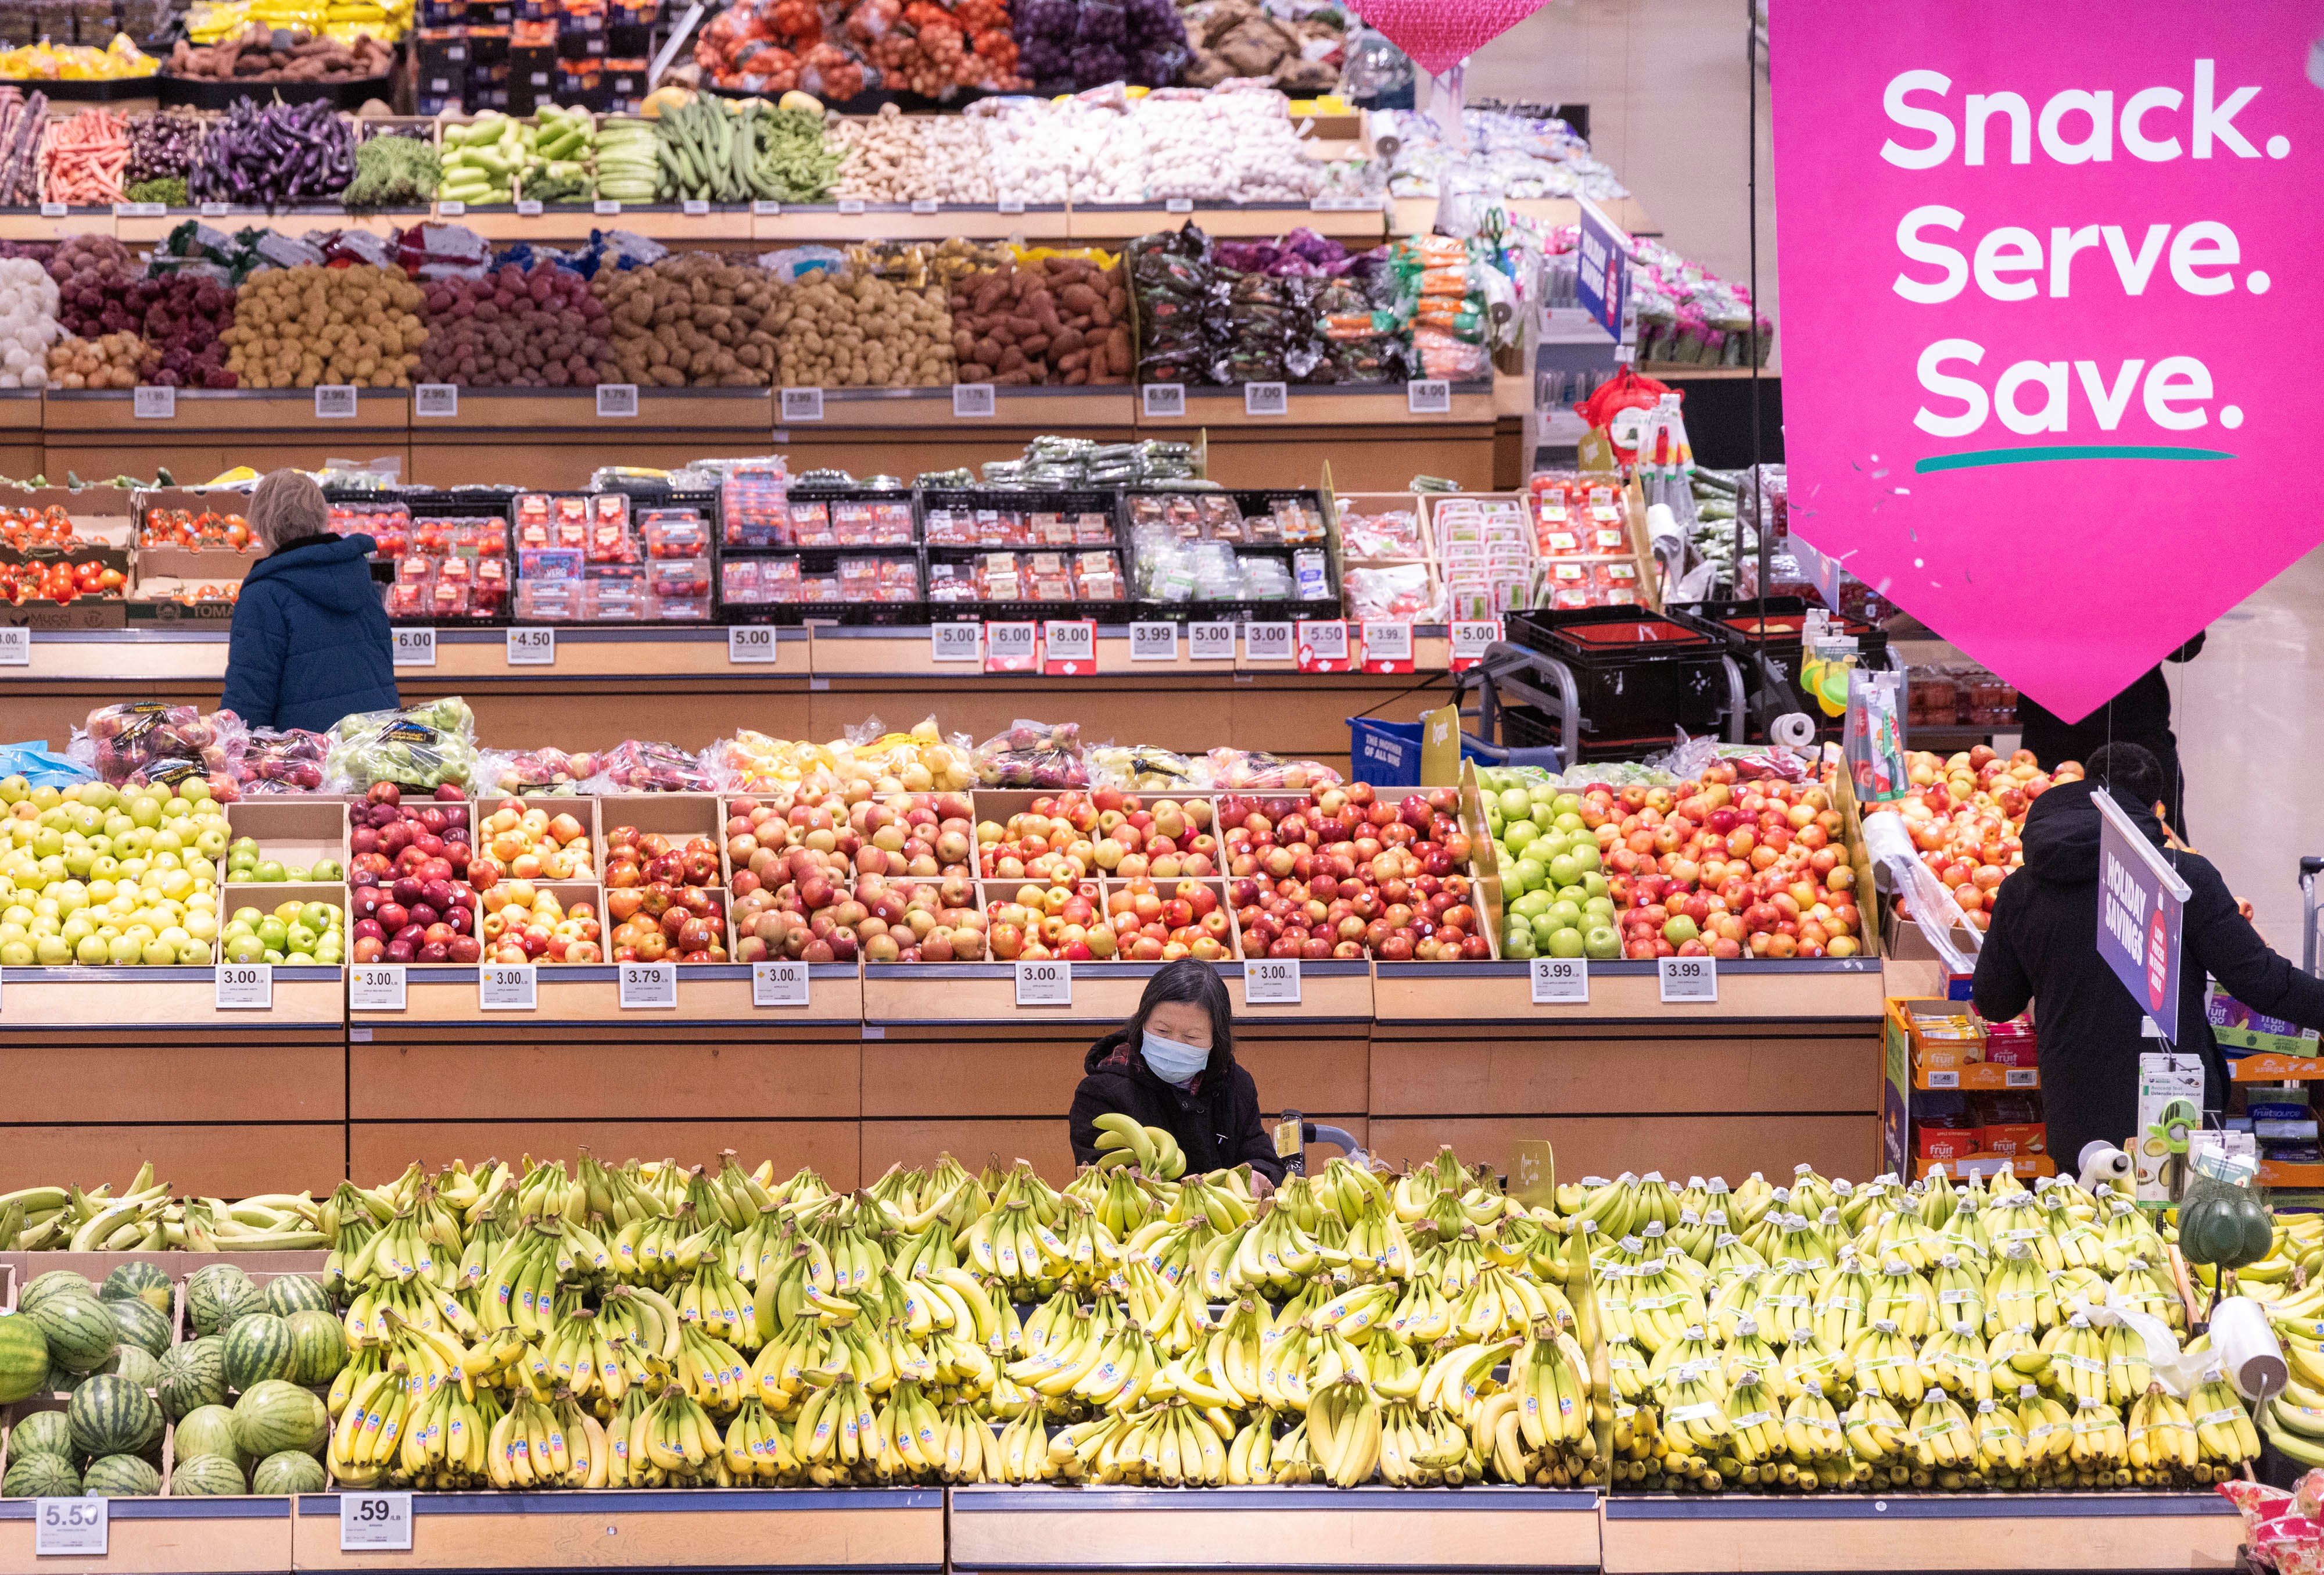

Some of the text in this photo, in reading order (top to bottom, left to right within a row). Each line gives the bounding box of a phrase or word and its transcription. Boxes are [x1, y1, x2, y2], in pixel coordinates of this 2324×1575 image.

[1880, 58, 2290, 170] Snack.
[1892, 205, 2271, 304] Serve.
[1249, 386, 1281, 398] 7.00
[1418, 385, 1446, 396] 4.00
[1913, 338, 2244, 437] Save.
[399, 633, 431, 647] 6.00
[518, 632, 550, 646] 4.50
[735, 631, 769, 644] 5.00
[944, 628, 974, 642] 5.00
[999, 628, 1031, 642] 6.00
[1057, 628, 1088, 641] 8.00
[1136, 627, 1170, 640] 3.99
[1195, 627, 1228, 640] 5.00
[1251, 627, 1286, 640] 3.00
[1311, 627, 1342, 640] 5.50
[1377, 629, 1398, 640] 3.99
[1463, 627, 1494, 640] 5.00
[1366, 733, 1378, 747] THE
[1365, 746, 1374, 756] OF
[1374, 749, 1387, 762] ALL
[2107, 851, 2147, 926] HOLIDAY
[2105, 892, 2144, 967] SAVINGS
[2154, 925, 2164, 944] LOW
[2151, 939, 2165, 963] PRICES
[770, 969, 794, 982] 3.00
[1024, 968, 1055, 980] 3.00
[1261, 966, 1285, 979] 3.00
[1540, 964, 1572, 978] 3.99
[1667, 964, 1701, 977] 3.99
[2153, 958, 2166, 980] EVERY
[224, 971, 256, 984] 3.00
[367, 972, 390, 985] 3.00
[497, 972, 521, 985] 3.00
[628, 970, 660, 983] 3.79
[2210, 1007, 2228, 1018] ruit
[2210, 1016, 2225, 1026] go
[2270, 1025, 2285, 1034] go
[1931, 1053, 1955, 1064] fruit
[1993, 1051, 2018, 1063] fruit
[1930, 1144, 1954, 1155] fruit
[1993, 1141, 2017, 1151] fruit
[354, 1500, 389, 1521] .59
